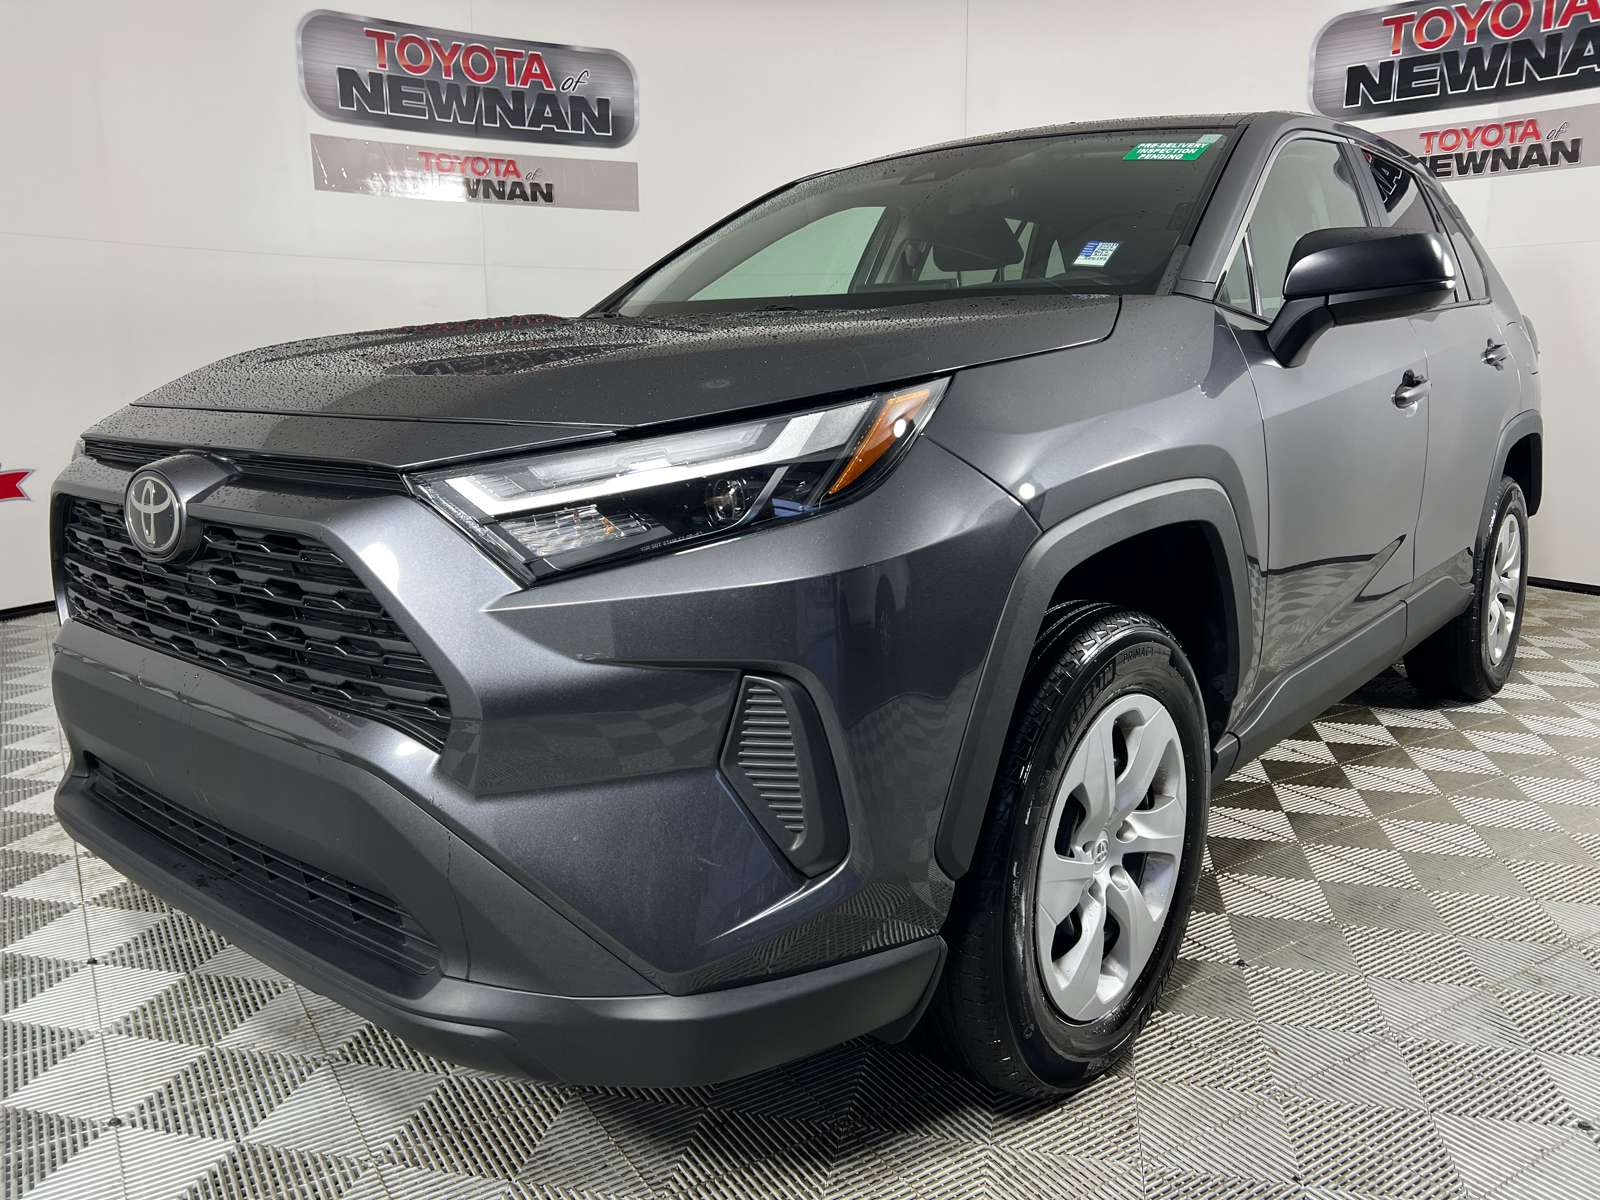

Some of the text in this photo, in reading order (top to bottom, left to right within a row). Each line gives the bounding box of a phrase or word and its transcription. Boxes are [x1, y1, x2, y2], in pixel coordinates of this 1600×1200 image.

[364, 27, 590, 93] TOYOTA of
[336, 65, 612, 136] NEWNAN
[418, 151, 542, 181] TOYOTA of
[1420, 118, 1569, 153] TOYOTA of
[1055, 663, 1114, 764] MICHELIN
